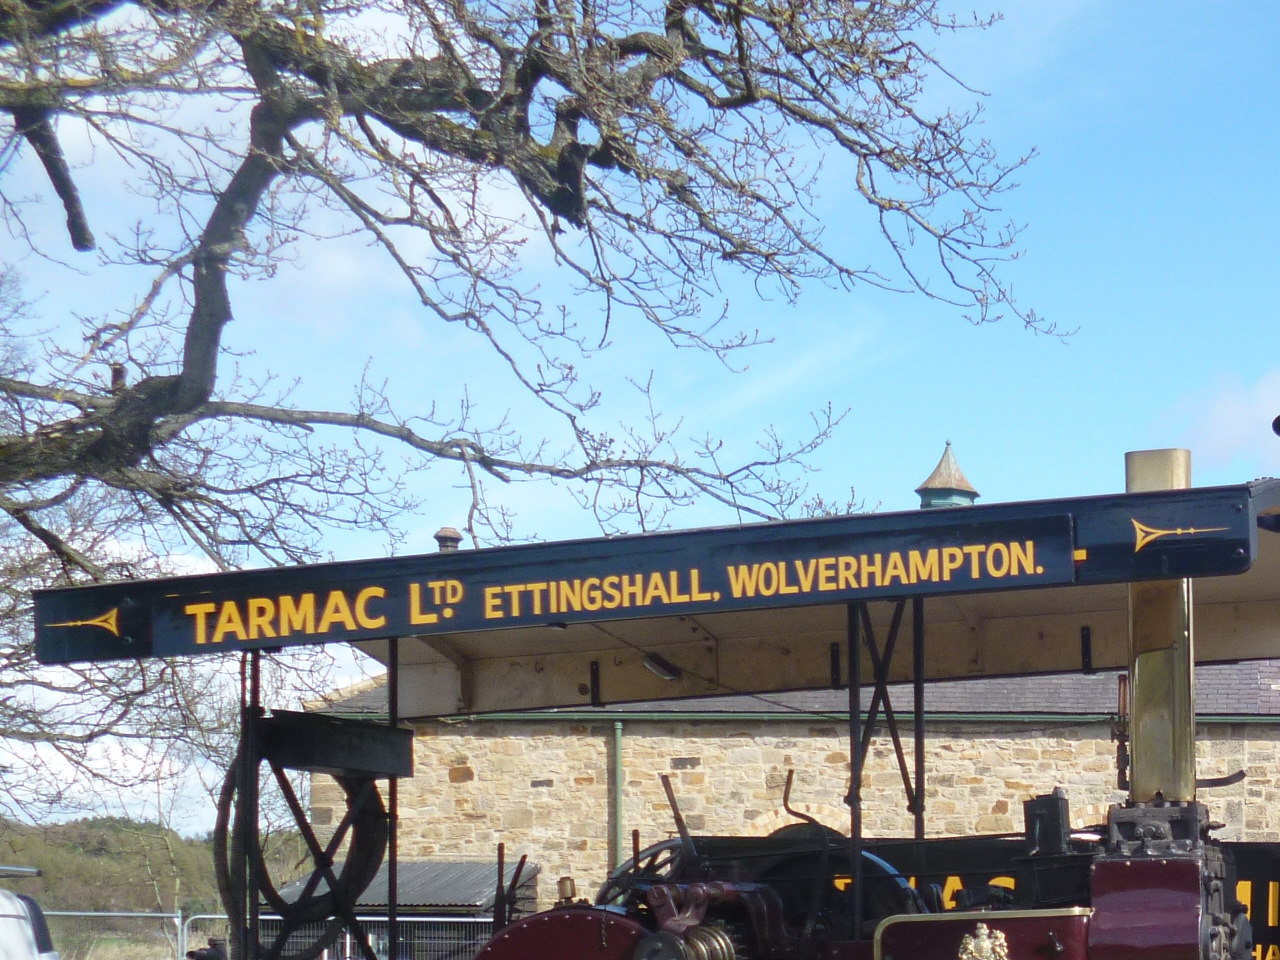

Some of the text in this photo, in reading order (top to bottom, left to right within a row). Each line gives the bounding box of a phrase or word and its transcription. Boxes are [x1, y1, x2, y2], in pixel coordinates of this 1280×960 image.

[184, 586, 387, 645] TARMAC
[483, 568, 722, 620] ETTINGSHALL,
[727, 540, 1045, 599] WOLVERHAMPTON.
